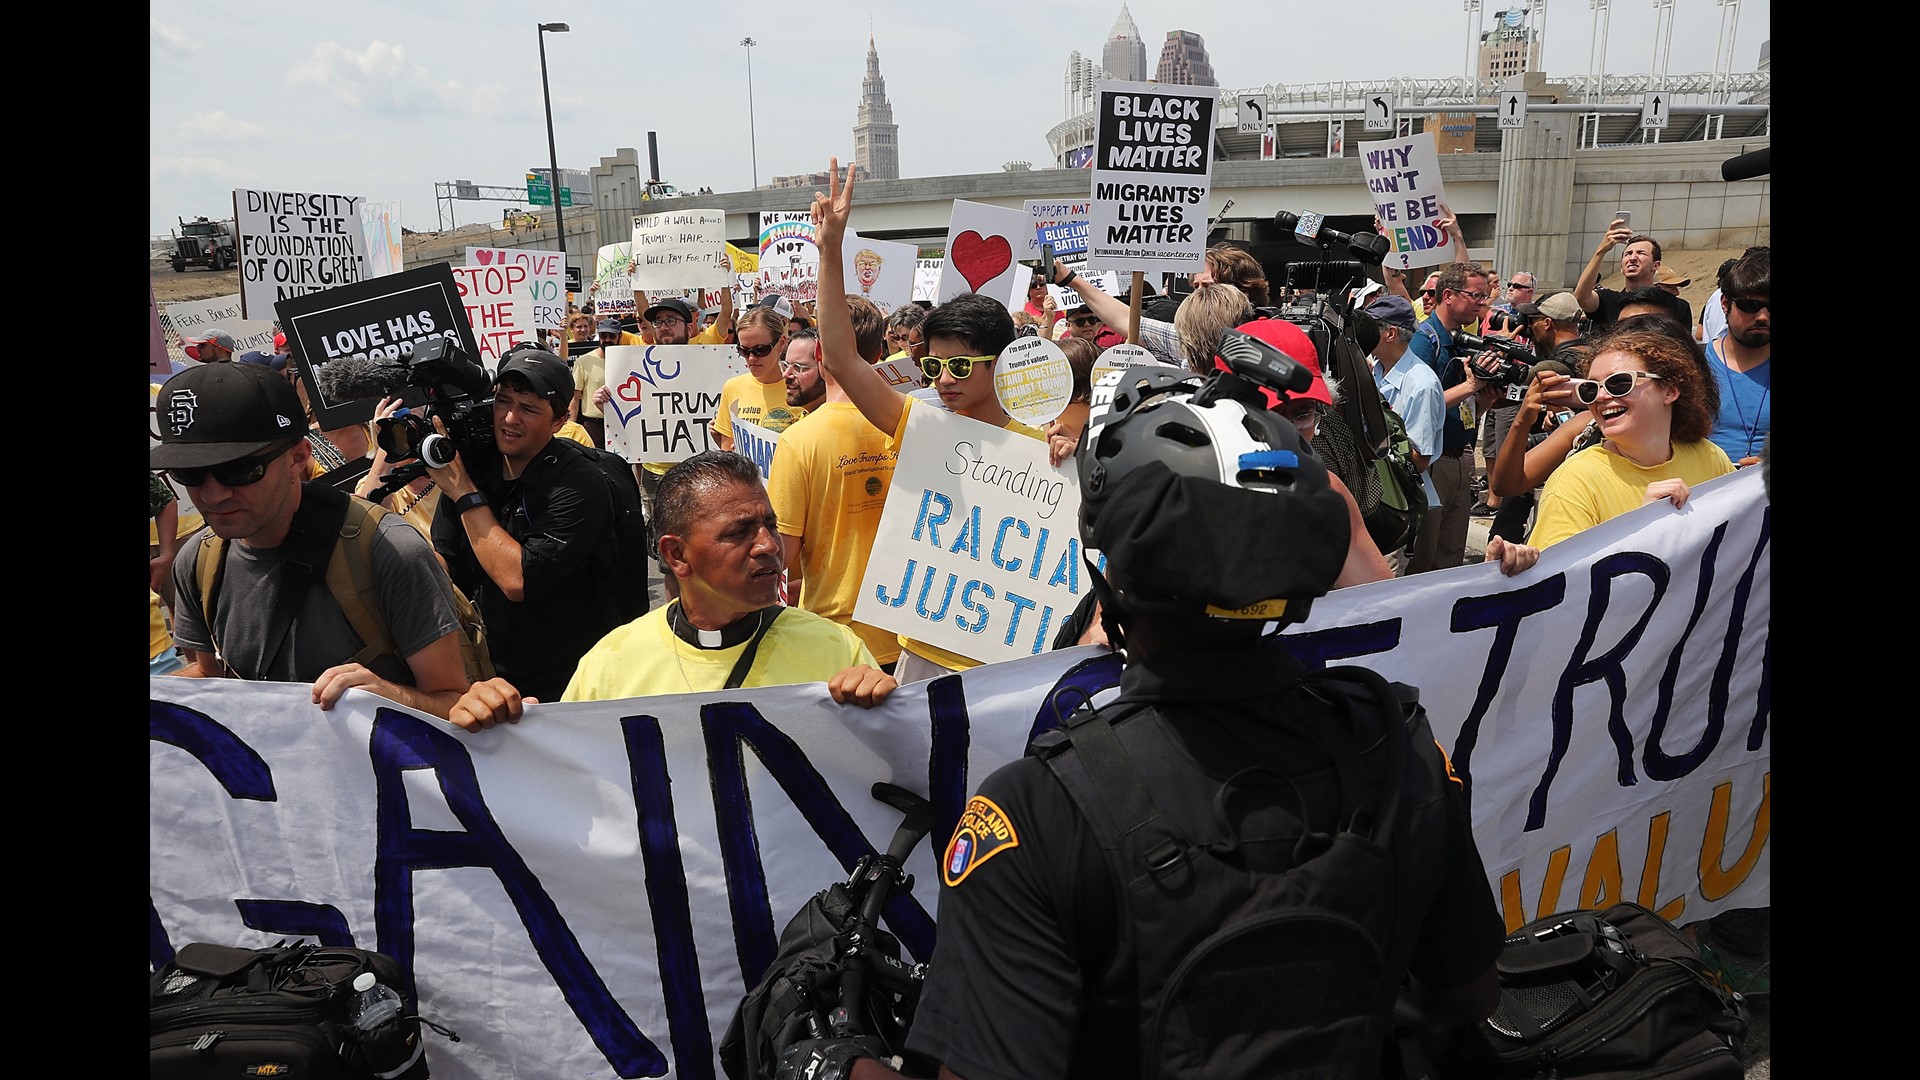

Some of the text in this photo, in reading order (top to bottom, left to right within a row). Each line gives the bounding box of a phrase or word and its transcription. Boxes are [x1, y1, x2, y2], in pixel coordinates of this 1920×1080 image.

[1501, 29, 1525, 39] at&t
[1113, 96, 1200, 121] BLACK
[1241, 122, 1264, 131] ONLY
[1368, 120, 1389, 128] ONLY
[1502, 117, 1521, 126] ONLY
[1646, 117, 1665, 125] ONLY
[1118, 121, 1192, 145] LIVES
[1108, 145, 1203, 169] MATTER
[1366, 144, 1414, 170] WHY
[1369, 170, 1420, 193] CAN'T
[247, 190, 359, 216] DIVERSITY
[1096, 182, 1206, 204] MIGRANTS'
[1032, 204, 1069, 217] SUPPORT
[1118, 203, 1184, 224] LIVES
[1375, 195, 1439, 221] WE BE
[270, 215, 347, 235] IS THE
[634, 216, 661, 229] BUILD
[664, 215, 670, 225] A
[673, 216, 696, 225] WALL
[763, 212, 811, 226] WE WANT
[1044, 227, 1071, 241] BLUE
[1107, 224, 1194, 244] MATTER
[1386, 219, 1449, 253] IENDS
[243, 235, 355, 256] FOUNDATION
[776, 242, 804, 255] NOT
[1157, 249, 1200, 261] iacenter.org
[646, 254, 665, 265] WILL
[668, 253, 683, 264] PAY
[685, 253, 700, 263] FOR
[703, 253, 712, 262] IT
[244, 256, 365, 284] OF OUR GREAT
[764, 270, 770, 284] A
[780, 266, 814, 281] WALL
[452, 265, 527, 297] STOP
[174, 313, 206, 329] FEAR
[464, 302, 515, 329] THE
[247, 331, 274, 350] LIMITS
[321, 310, 436, 358] LOVE HAS
[1031, 339, 1042, 348] FAN
[352, 330, 460, 361] BORDS
[997, 361, 1067, 388] STAND TOGETHER
[1002, 382, 1036, 400] AGAINST
[1038, 375, 1067, 391] TRUMP
[651, 391, 722, 415] TRUM
[1086, 370, 1127, 451] BELL
[836, 454, 858, 469] Love
[858, 451, 889, 465] Trumps
[944, 440, 1065, 520] Standing
[911, 488, 1106, 596] RACIA
[875, 558, 1073, 655] JUSTI
[961, 814, 992, 841] POLICE
[256, 1064, 279, 1075] MTX
